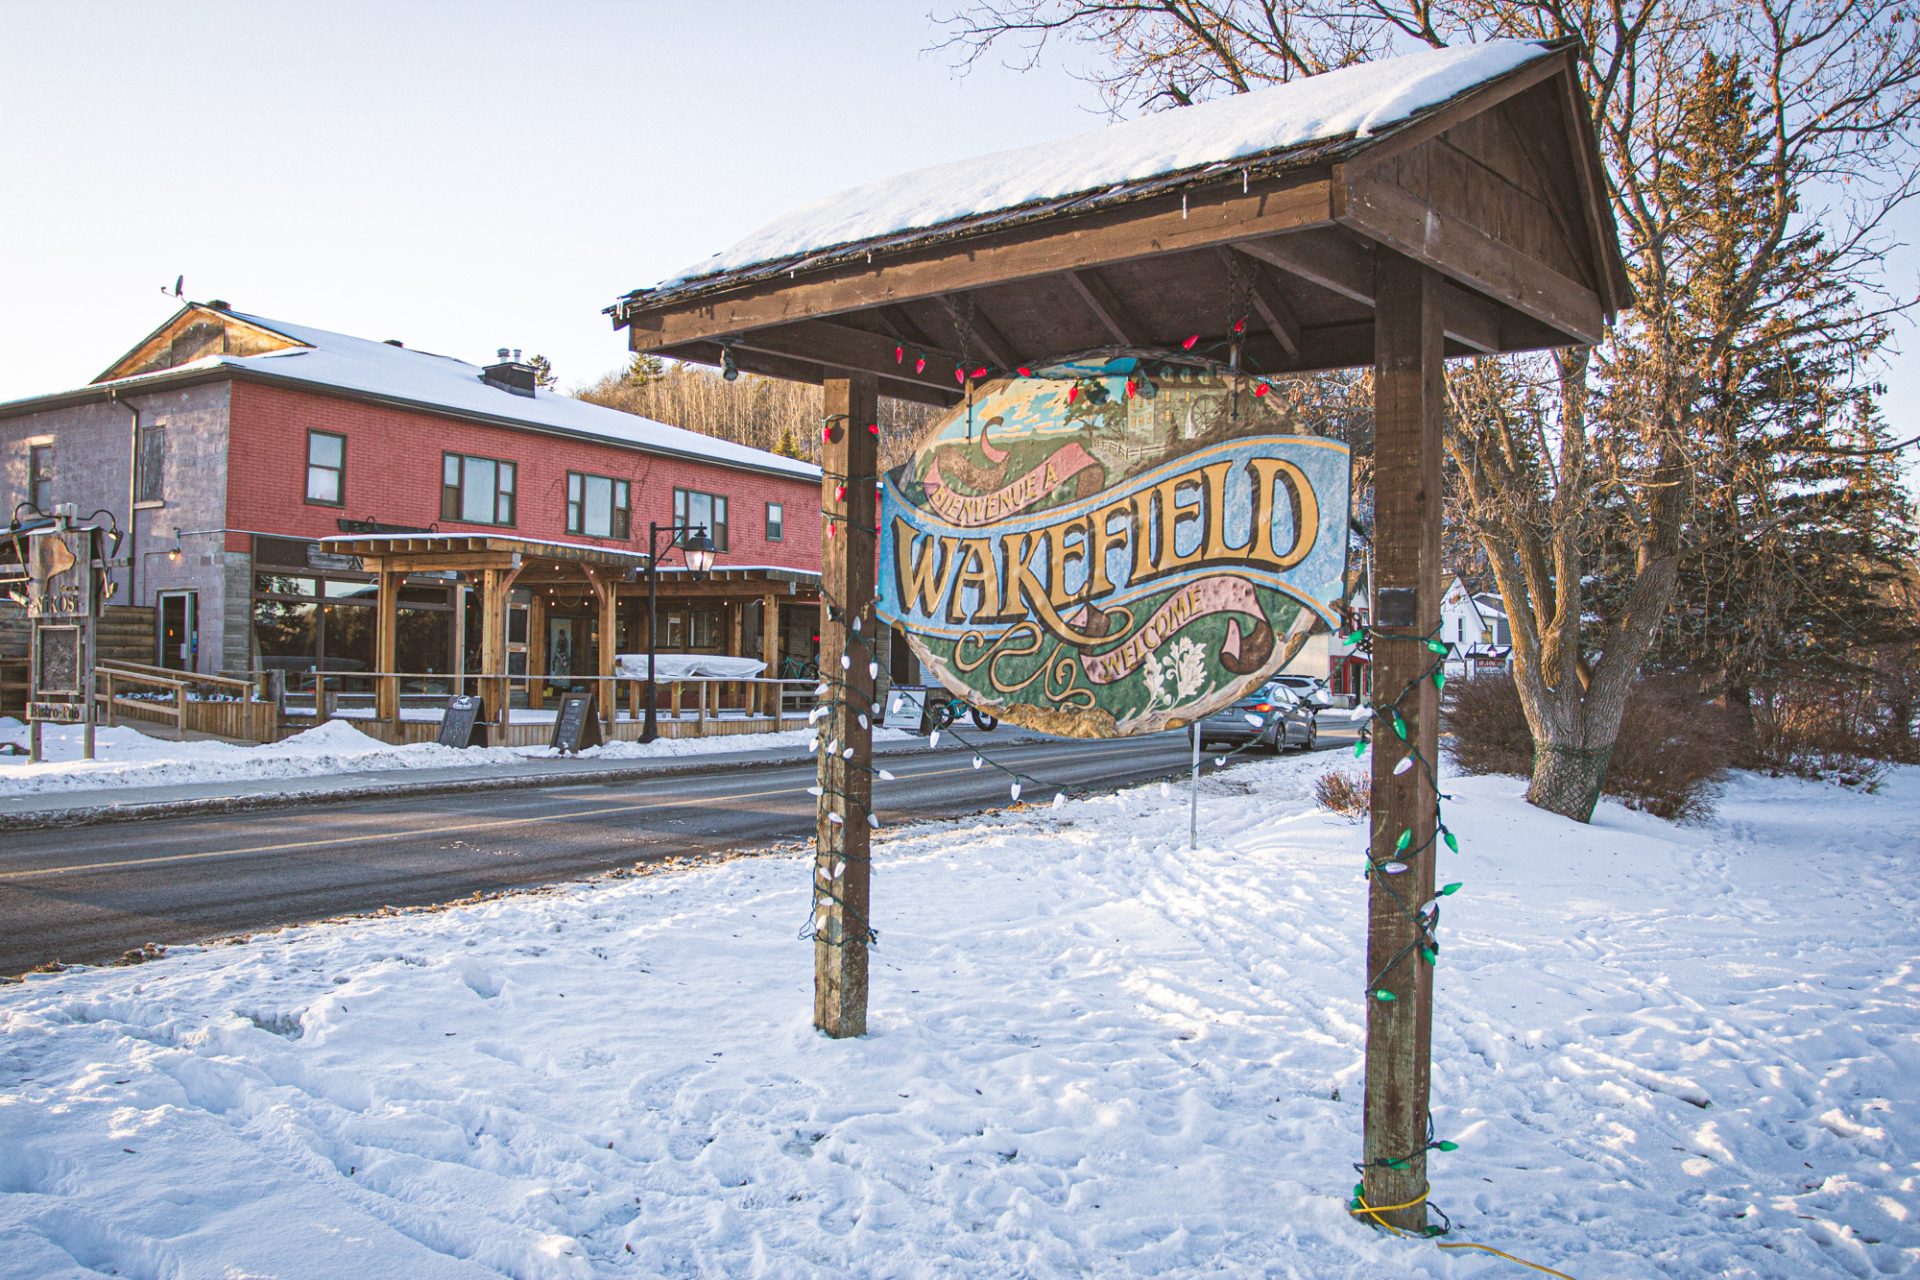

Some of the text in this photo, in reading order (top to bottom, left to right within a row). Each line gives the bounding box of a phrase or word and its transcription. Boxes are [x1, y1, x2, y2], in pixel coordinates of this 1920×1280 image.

[930, 475, 1038, 522] BIENVENUE
[892, 457, 1319, 643] WAKEFIELD
[1100, 586, 1204, 678] WELCOME
